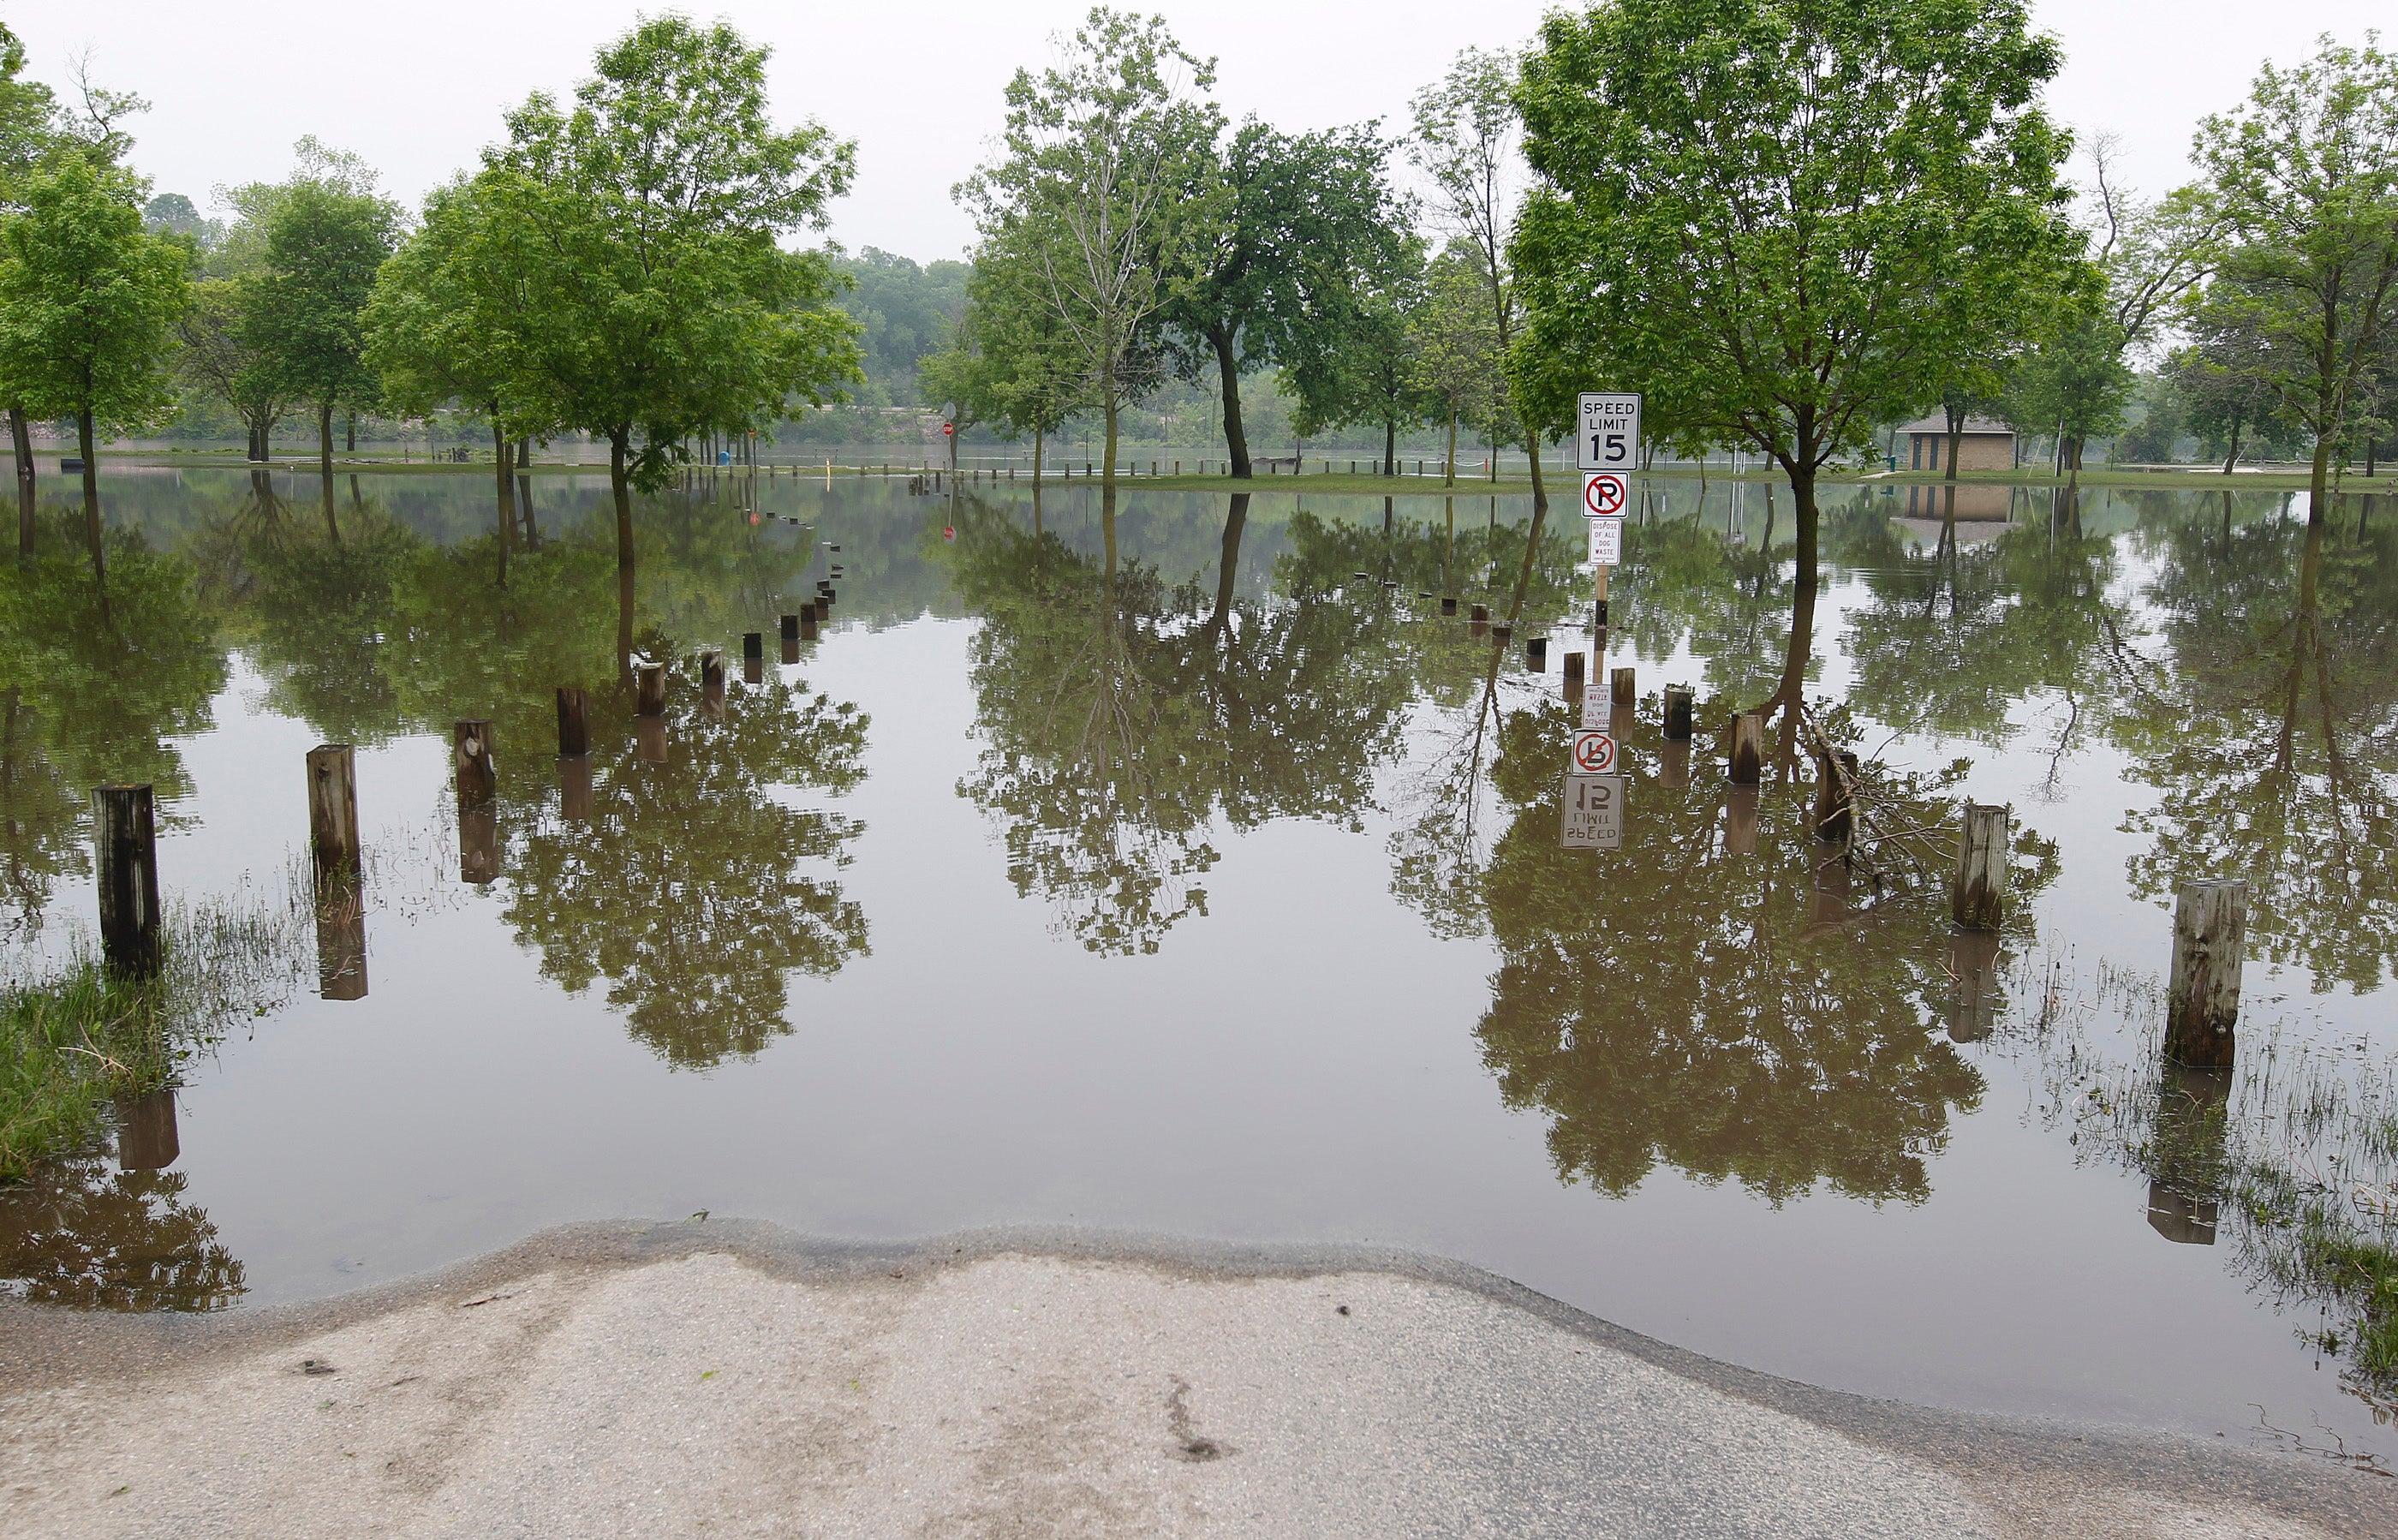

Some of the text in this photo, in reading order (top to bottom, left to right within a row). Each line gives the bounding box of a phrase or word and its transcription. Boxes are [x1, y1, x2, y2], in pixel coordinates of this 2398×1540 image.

[1584, 403, 1635, 415] SPEED
[1590, 419, 1628, 430] LIMIT
[1590, 434, 1626, 462] 15
[1598, 482, 1618, 507] P
